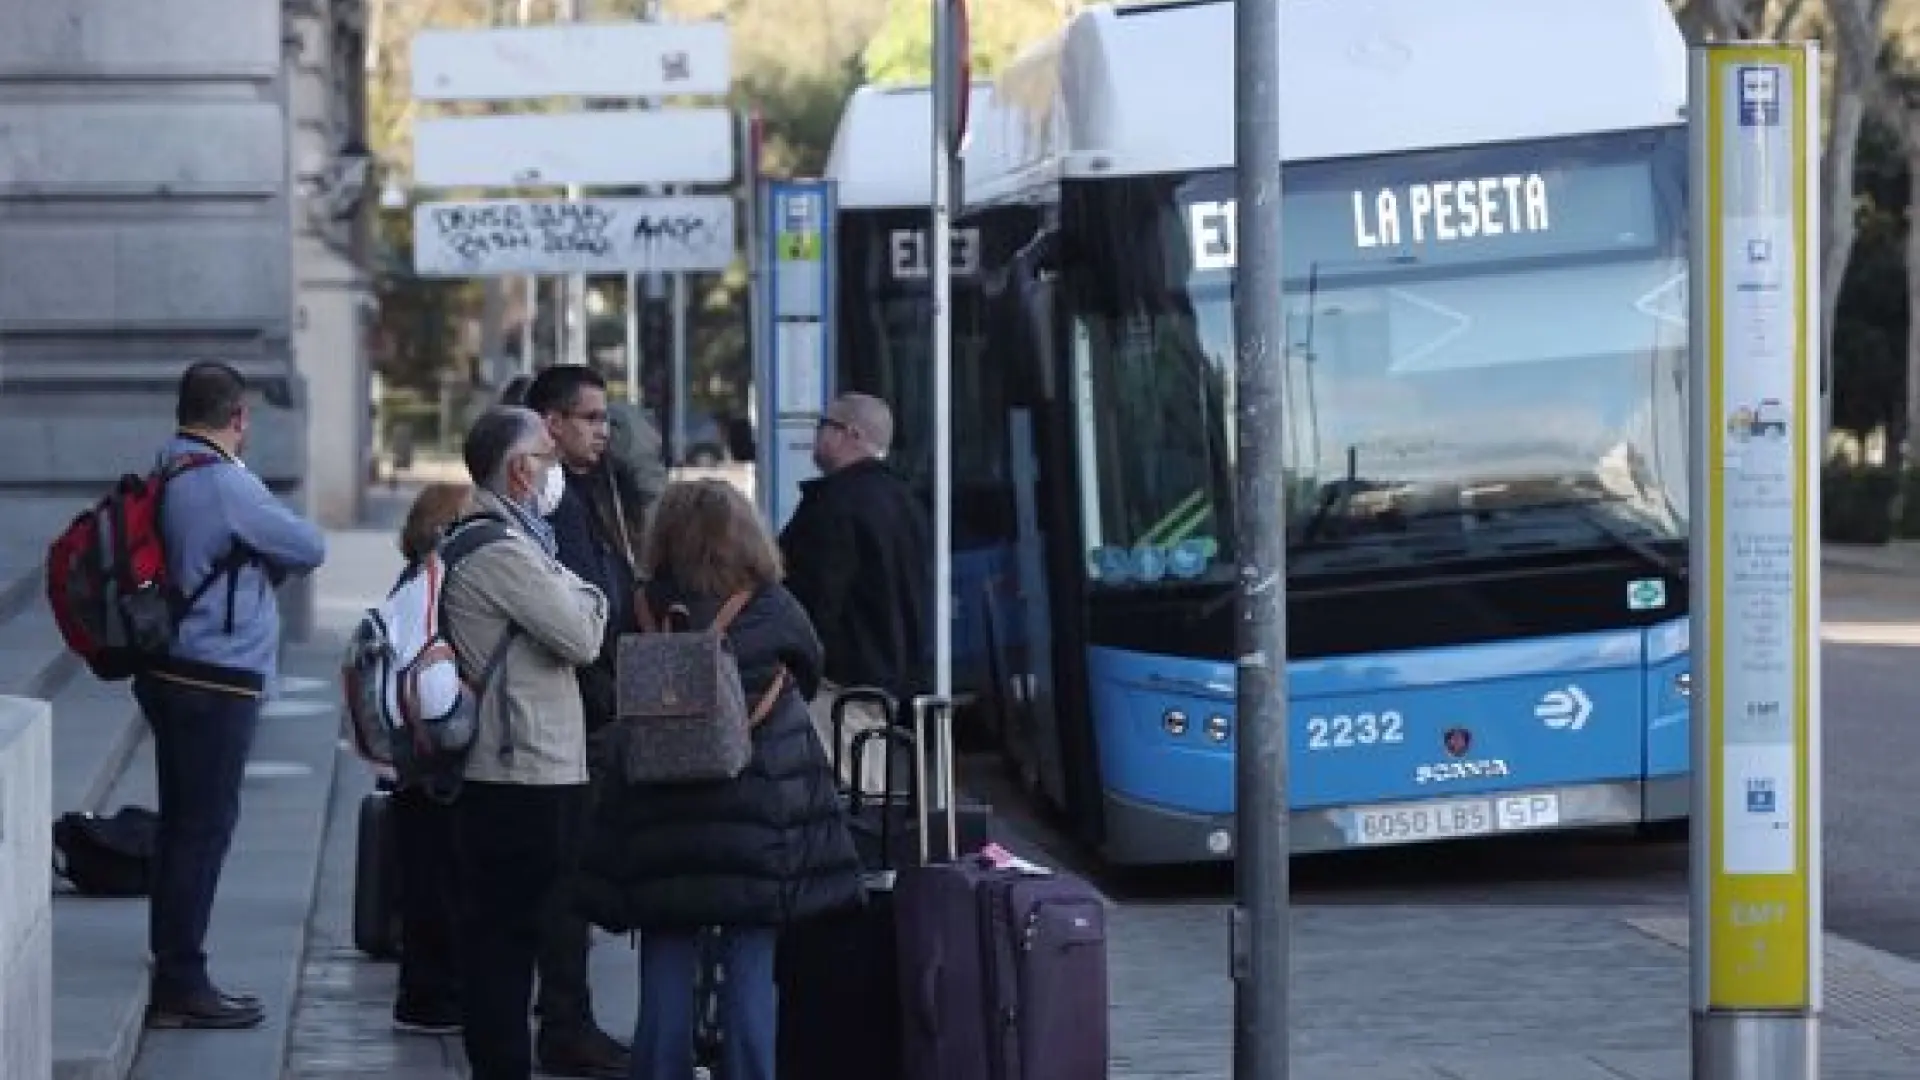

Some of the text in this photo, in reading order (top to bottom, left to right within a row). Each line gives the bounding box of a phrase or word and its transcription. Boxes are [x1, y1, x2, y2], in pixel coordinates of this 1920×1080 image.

[1353, 187, 1400, 247] LA
[1410, 173, 1549, 243] PESETA
[1308, 711, 1404, 750] 2232
[1506, 797, 1550, 824] SP
